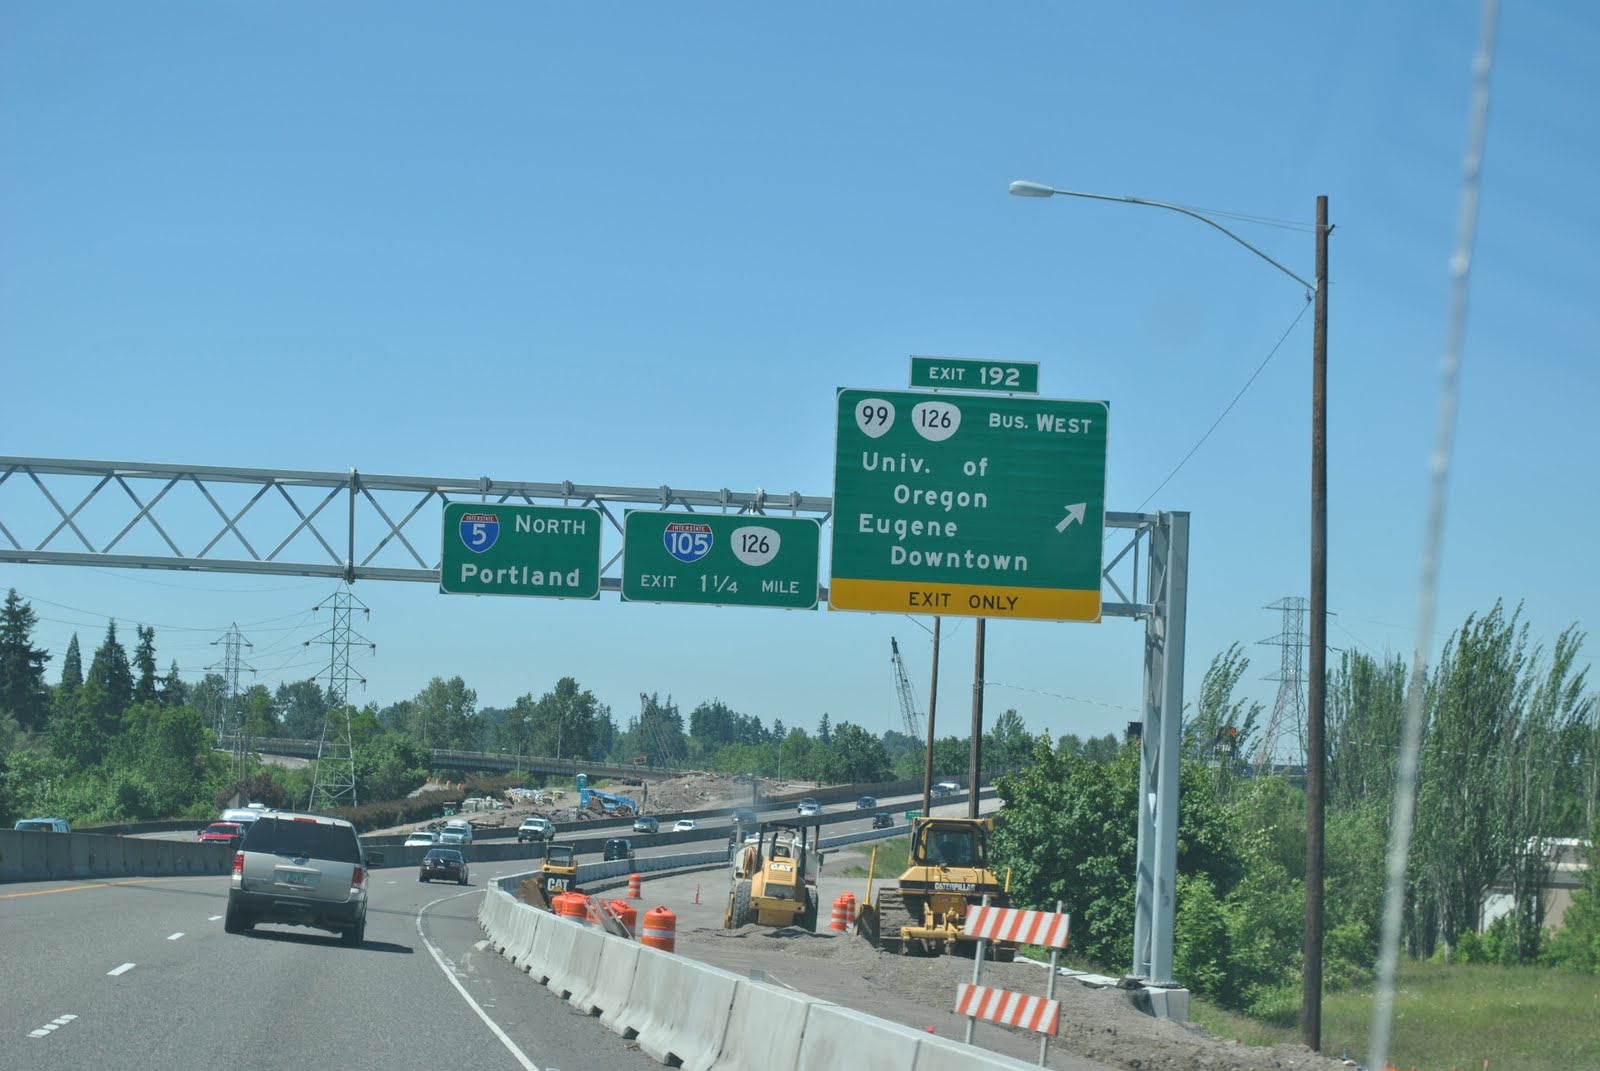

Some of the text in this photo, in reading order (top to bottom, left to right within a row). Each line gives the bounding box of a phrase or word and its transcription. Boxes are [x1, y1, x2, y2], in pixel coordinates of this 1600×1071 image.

[928, 366, 1021, 387] EXIT 192
[862, 405, 889, 427] 99
[921, 409, 951, 429] 126
[1036, 413, 1092, 434] WEST
[862, 451, 988, 477] Univ. of
[893, 484, 988, 512] Oregon
[471, 523, 487, 546] 5
[515, 514, 586, 535] NORTH
[858, 513, 958, 541] Eugene
[670, 532, 709, 556] 105
[741, 534, 770, 554] 126
[890, 545, 1028, 571] Downtown
[461, 563, 580, 587] Portland
[640, 574, 677, 588] EXIT
[761, 580, 799, 594] MILE
[908, 591, 1019, 611] EXIT ONLY
[547, 877, 570, 892] CAT
[934, 881, 976, 892] CATERPILLAR
